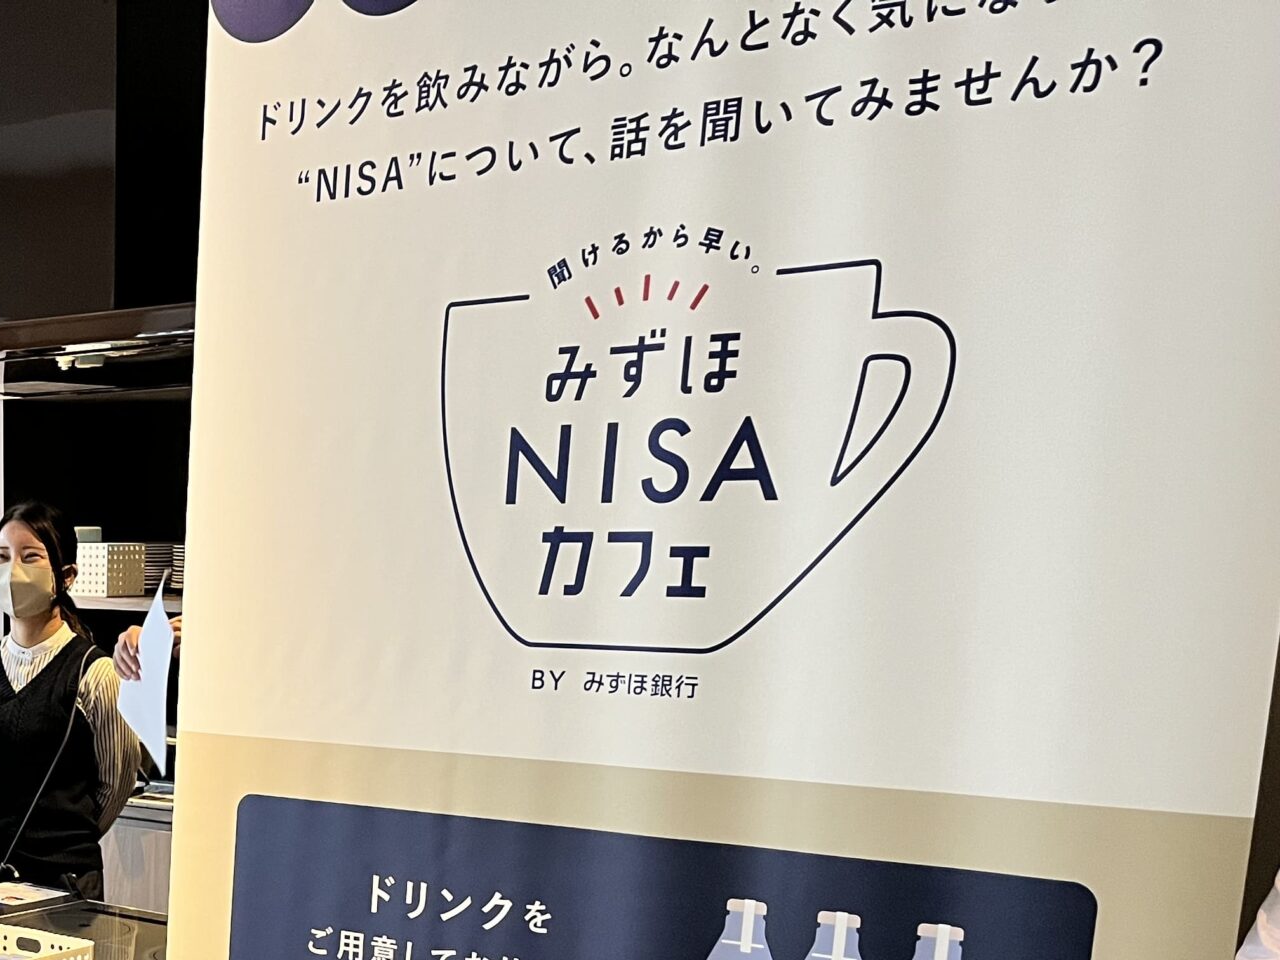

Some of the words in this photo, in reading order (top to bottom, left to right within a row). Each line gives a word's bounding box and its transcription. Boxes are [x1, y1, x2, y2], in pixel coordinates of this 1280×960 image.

[547, 223, 760, 290] 聞けるから早い。
[546, 327, 741, 402] みずほ
[505, 415, 778, 505] NISA
[538, 526, 710, 598] カフェ
[531, 669, 567, 691] BY
[583, 671, 699, 699] みずほ銀行
[369, 874, 553, 934] ドリンクを
